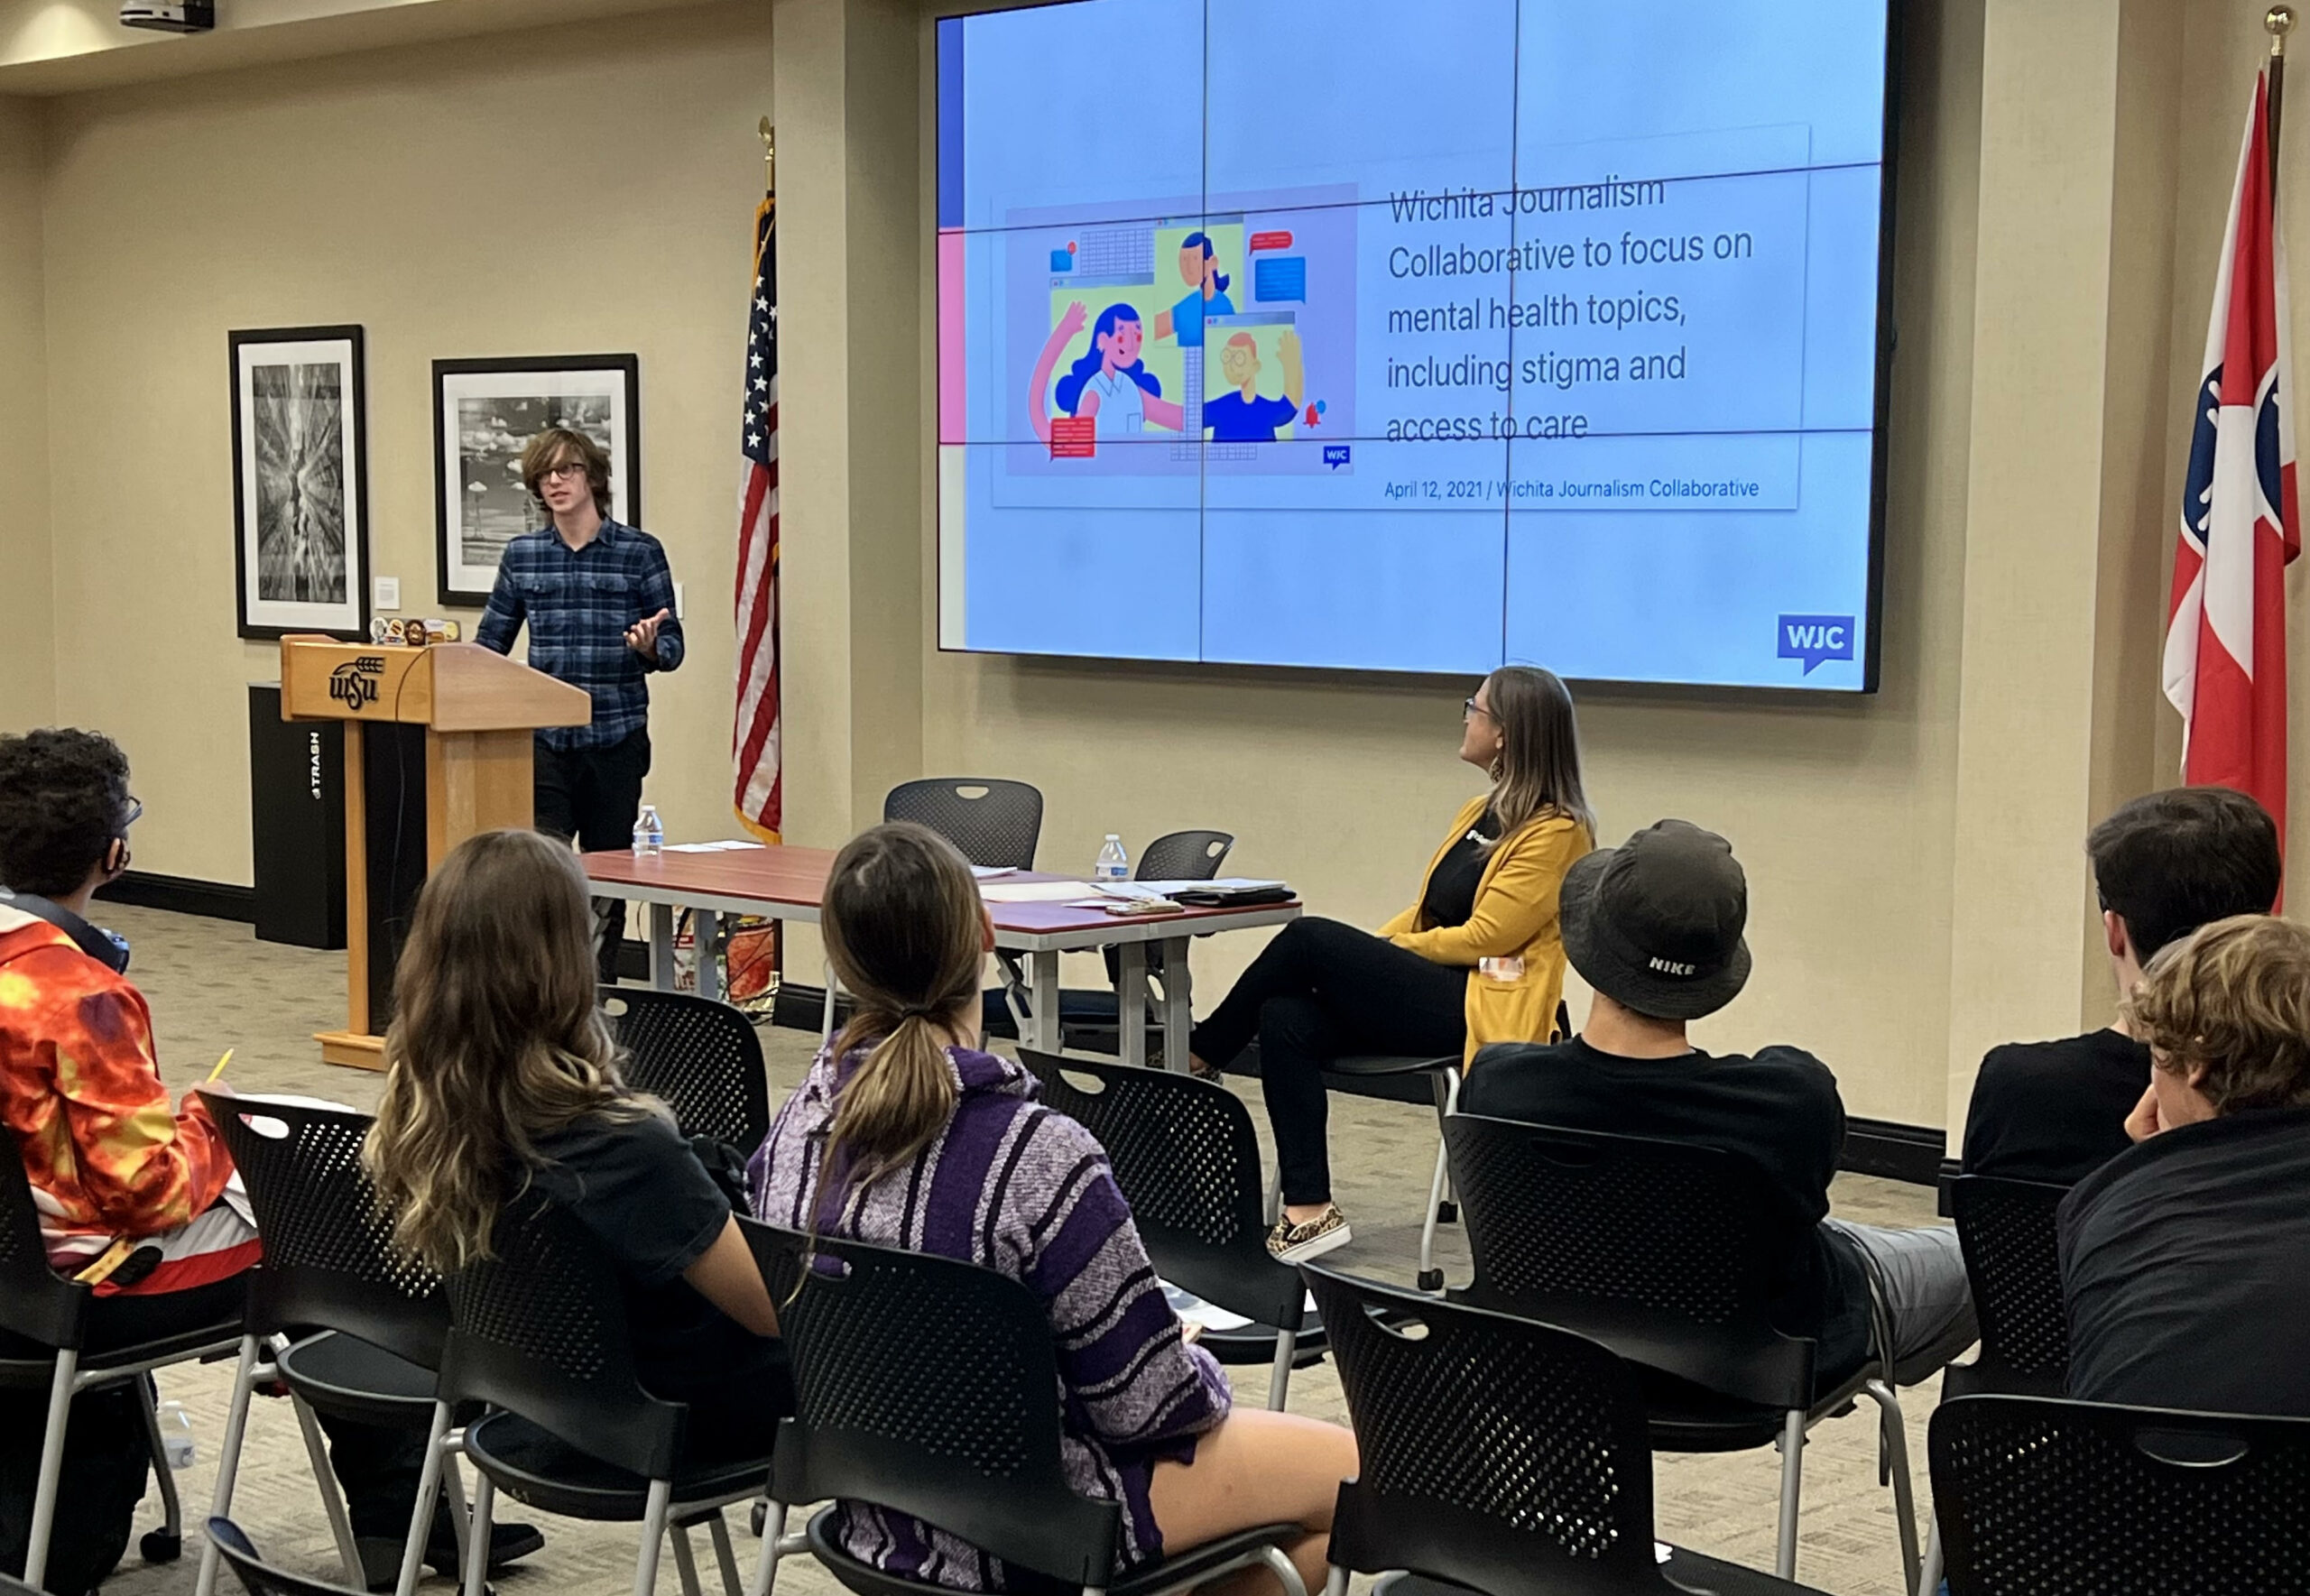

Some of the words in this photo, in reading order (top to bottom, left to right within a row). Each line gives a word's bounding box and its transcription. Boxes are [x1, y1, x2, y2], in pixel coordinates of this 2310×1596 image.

[1391, 187, 1493, 223] Wichita
[1502, 175, 1665, 216] Journalism
[1389, 239, 1575, 278] Collaborative
[1584, 240, 1612, 267] to
[1621, 231, 1704, 264] focus
[1714, 232, 1752, 260] on
[1388, 298, 1480, 333] mental
[1489, 293, 1578, 328] health
[1587, 290, 1686, 331] topics,
[1387, 354, 1512, 391] including
[1521, 351, 1620, 390] stigma
[1629, 346, 1686, 379] and
[1387, 413, 1482, 442] access
[1490, 411, 1517, 439] to
[1526, 413, 1588, 438] care
[1326, 449, 1347, 460] WJC
[1384, 480, 1418, 501] April
[1422, 480, 1441, 500] 12,
[1446, 480, 1483, 497] 2021
[1496, 480, 1554, 497] Wichita
[1558, 479, 1644, 497] Journalism
[1649, 478, 1760, 497] Collaborative
[1787, 624, 1844, 650] WJC
[310, 732, 320, 787] TRASH
[1649, 956, 1696, 975] NIKE
